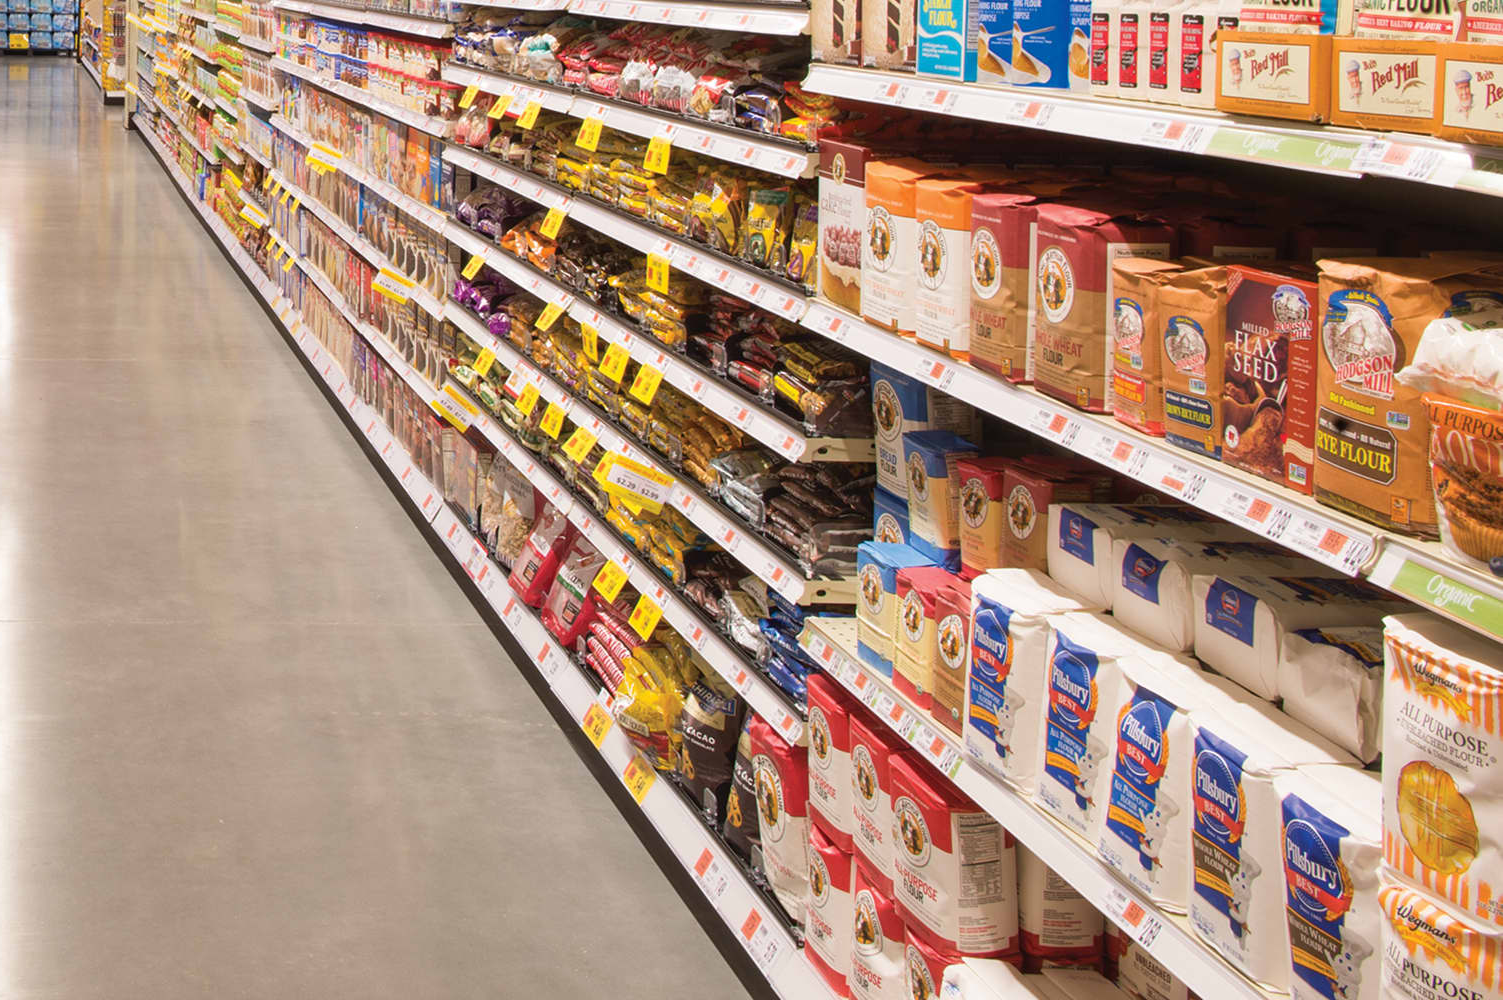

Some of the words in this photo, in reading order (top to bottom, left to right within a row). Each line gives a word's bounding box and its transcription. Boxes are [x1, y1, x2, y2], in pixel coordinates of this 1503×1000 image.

[928, 9, 957, 29] FLOUR
[1251, 59, 1268, 80] Red
[1269, 49, 1289, 74] Mill
[1371, 70, 1393, 94] Red
[1393, 58, 1418, 88] Mill
[1241, 321, 1269, 337] MILLED
[1043, 348, 1063, 367] FLOUR
[1053, 338, 1084, 358] WHEAT
[1235, 330, 1277, 362] FLAX
[1234, 352, 1278, 383] SEED
[1336, 355, 1393, 384] HODGSON
[1363, 372, 1394, 395] MILL
[1317, 429, 1338, 455] RYE
[1339, 436, 1392, 474] FLOUR
[1426, 574, 1483, 613] Organic
[975, 623, 1006, 660] Pillsbury
[979, 648, 996, 667] BEST
[1051, 664, 1088, 705] Pillsbury
[1414, 660, 1463, 694] Wegmans
[1058, 693, 1077, 712] BEST
[1121, 714, 1160, 757] Pillsbury
[1400, 701, 1424, 723] ALL
[1422, 713, 1489, 757] PURPOSE
[1126, 744, 1147, 765] BEST
[1449, 744, 1485, 768] FLOUR
[1197, 766, 1238, 815] Pillsbury
[1203, 799, 1226, 825] BEST
[1286, 837, 1337, 890] Pillsbury
[1295, 874, 1322, 900] BEST
[1397, 903, 1459, 953] Wegmans
